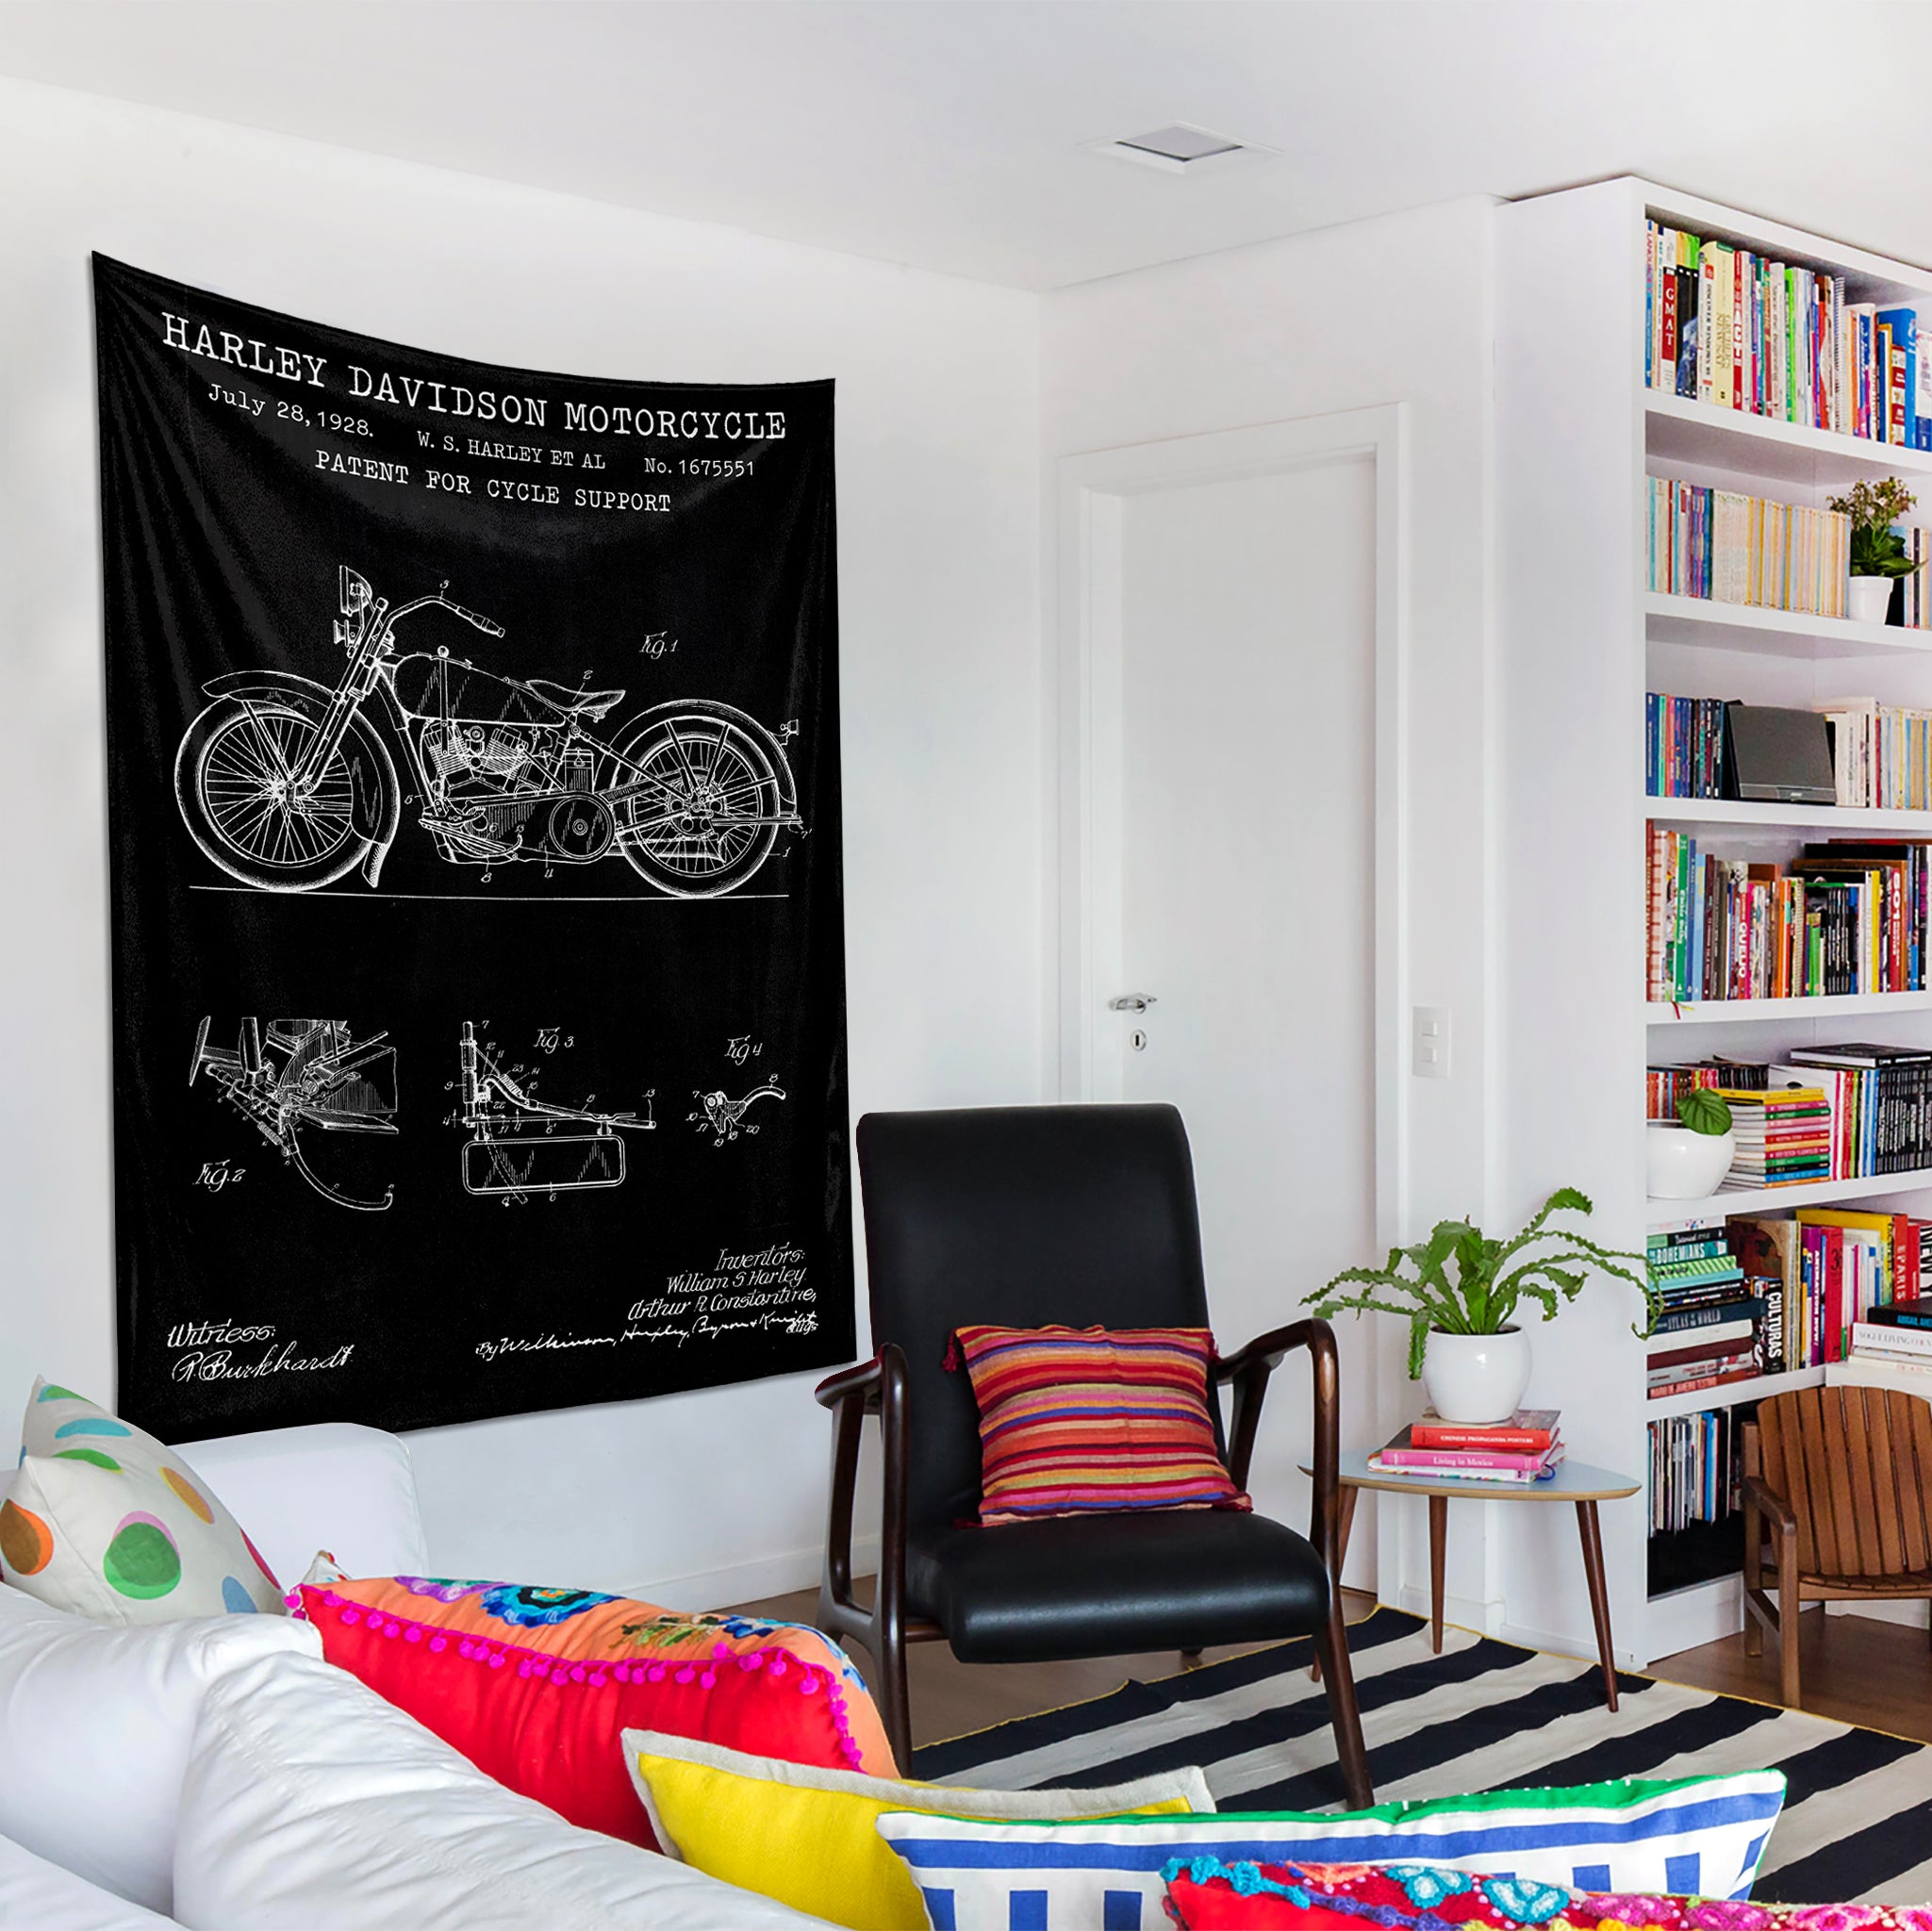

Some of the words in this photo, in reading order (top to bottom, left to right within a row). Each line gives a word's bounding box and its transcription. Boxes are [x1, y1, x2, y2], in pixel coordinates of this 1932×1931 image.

[1665, 288, 1676, 346] GMAT
[161, 312, 327, 388] HARLEY
[348, 365, 548, 426] DAVIDSON
[564, 402, 786, 439] MOTORCYCLE
[208, 384, 266, 416] July
[417, 431, 435, 449] W.
[443, 436, 460, 453] S.
[468, 438, 542, 464] HARLEY
[551, 450, 574, 467] ET
[582, 454, 606, 470] AL
[315, 450, 409, 486] PATENT
[425, 470, 472, 494] FOR
[487, 479, 560, 504] CYCLE
[574, 488, 671, 512] SUPPORT
[644, 457, 672, 474] No.
[679, 459, 754, 478] 1675551
[1738, 921, 1747, 978] QUEIJO
[232, 1168, 246, 1182] 2
[714, 1242, 806, 1271] Inventors:
[1657, 1243, 1706, 1264] BOHEMIANS
[667, 1269, 729, 1295] William
[1896, 1255, 1906, 1299] PARIS
[628, 1299, 691, 1321] Arthur
[1768, 1291, 1782, 1359] CULTURAS
[167, 1317, 277, 1348] Witness:
[475, 1340, 497, 1362] By
[1433, 1457, 1457, 1466] Living
